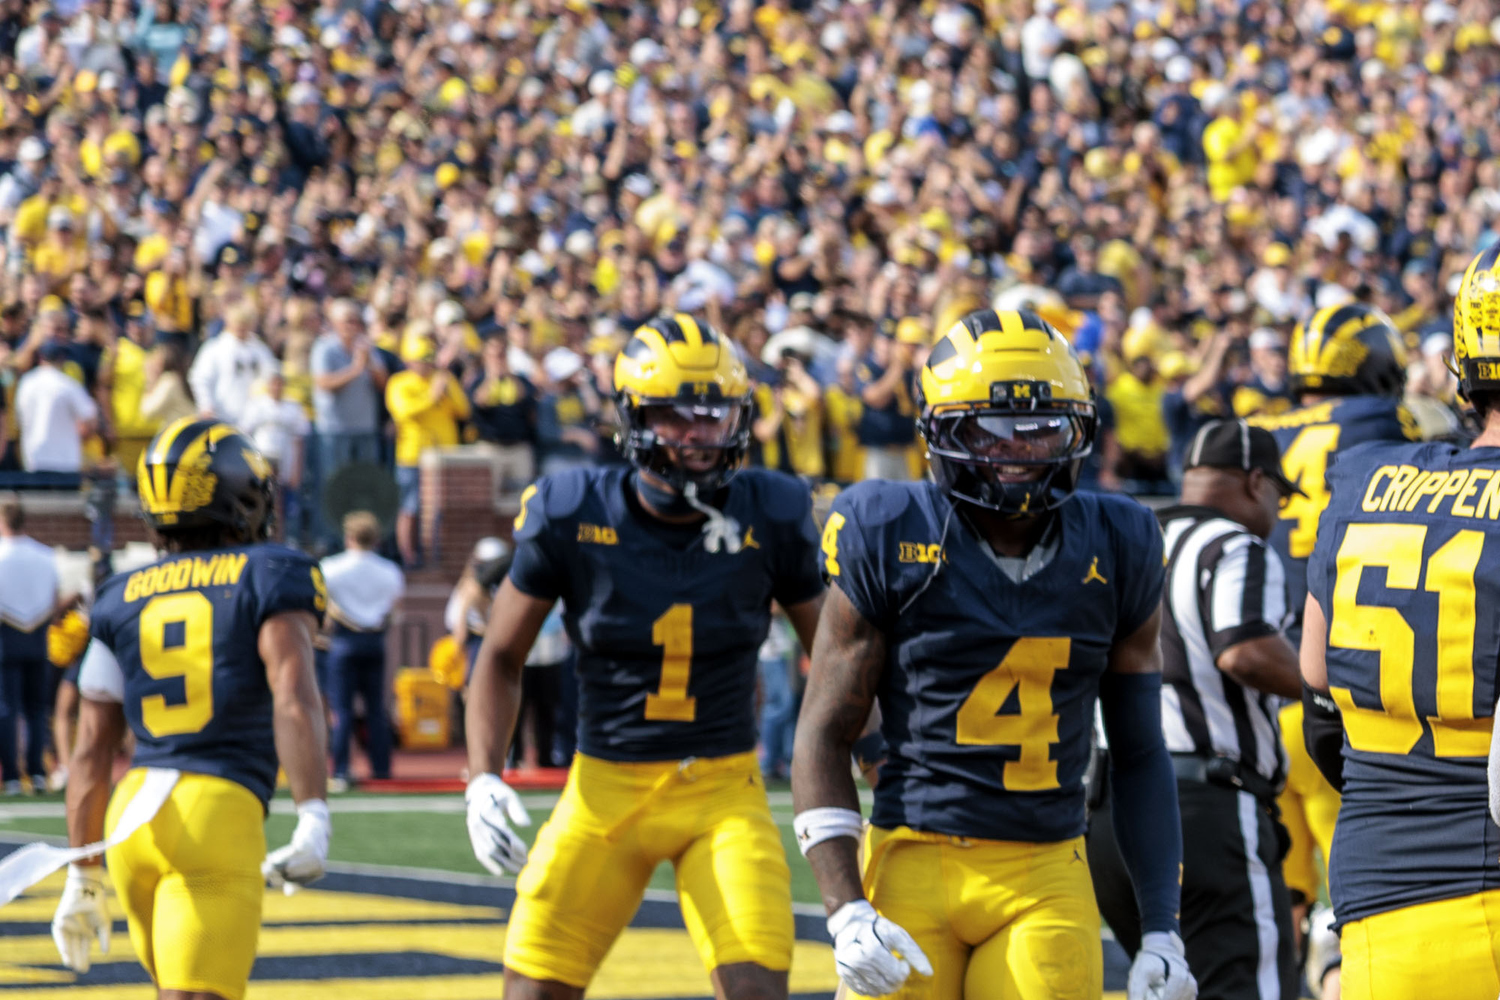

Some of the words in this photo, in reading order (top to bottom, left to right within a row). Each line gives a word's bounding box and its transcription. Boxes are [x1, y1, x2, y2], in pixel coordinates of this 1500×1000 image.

[1013, 384, 1030, 398] M
[124, 553, 247, 603] GOODWIN
[1329, 523, 1494, 757] 51
[139, 590, 214, 738] 9
[644, 603, 696, 722] 1
[956, 637, 1071, 791] 4
